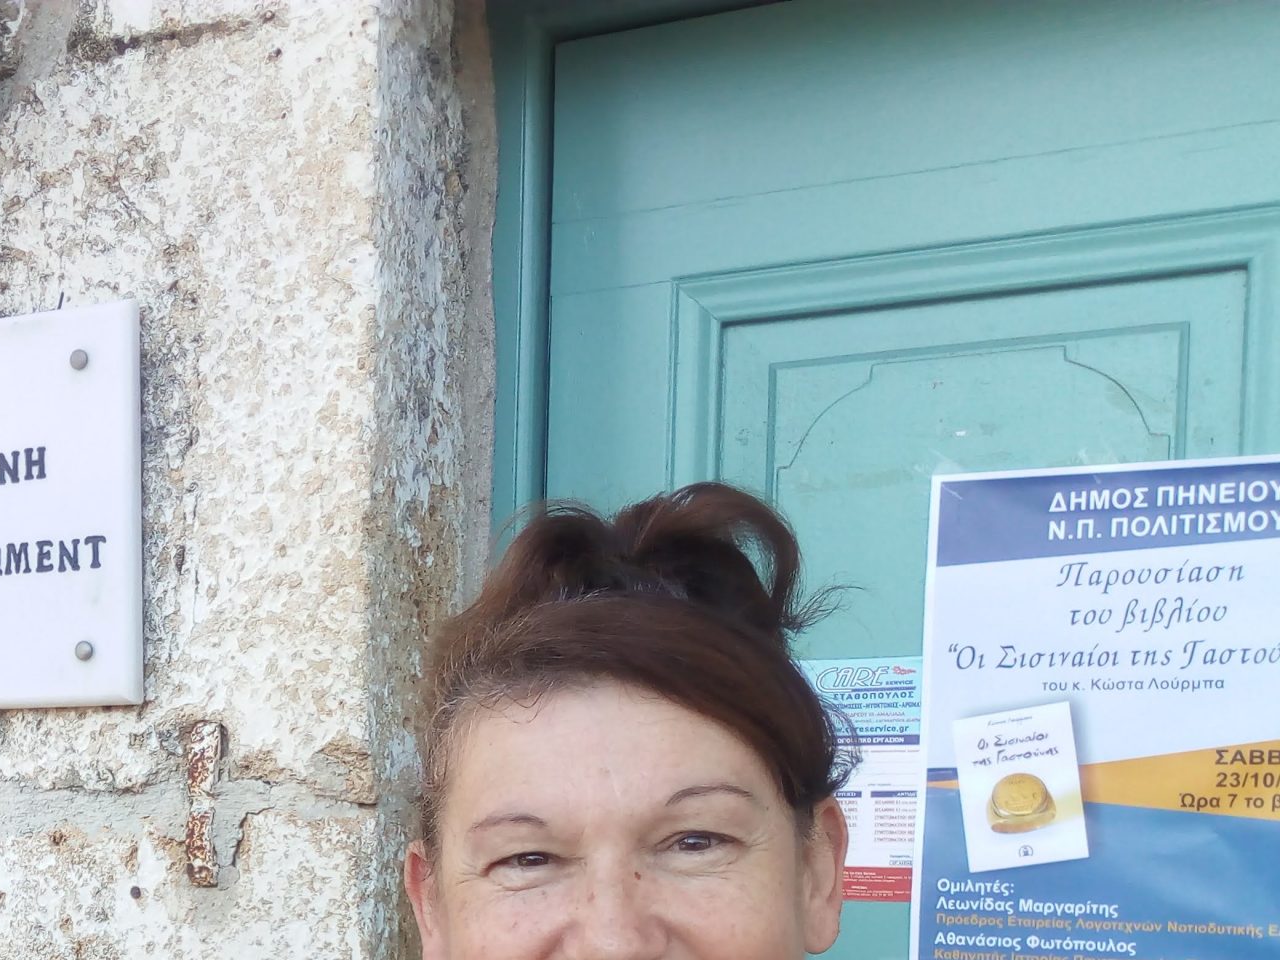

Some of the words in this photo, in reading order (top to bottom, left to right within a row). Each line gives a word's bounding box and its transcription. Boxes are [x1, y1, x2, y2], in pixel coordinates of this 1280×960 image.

[1048, 486, 1149, 513] ΔΗΜΟΣ
[1048, 517, 1102, 541] Ν.Π.
[1056, 559, 1245, 594] Παρουσίαση
[1069, 607, 1113, 627] του
[1115, 597, 1228, 632] βιβλίου
[995, 643, 1120, 670] Σισιναίοι
[1131, 649, 1172, 668] της
[816, 666, 890, 693] CARE
[1042, 680, 1068, 692] του
[1072, 680, 1086, 692] κ.
[1091, 677, 1144, 691] Κώστα
[1147, 677, 1225, 693] Λούρμπα
[1228, 793, 1238, 808] 7
[1244, 797, 1264, 808] το
[937, 878, 1015, 896] Ομιλητές:
[936, 896, 1014, 914] Λεωνίδας
[1019, 899, 1118, 918] Μαργαρίτης
[936, 913, 1004, 929] Πρόεδρος
[1007, 915, 1072, 931] Εταιρείας
[1075, 918, 1163, 935] Λογοτεχνών
[1167, 921, 1264, 939] Νοτιοδυτικής
[934, 932, 1022, 951] Αθανάσιος
[1026, 935, 1137, 956] Φωτόπουλος
